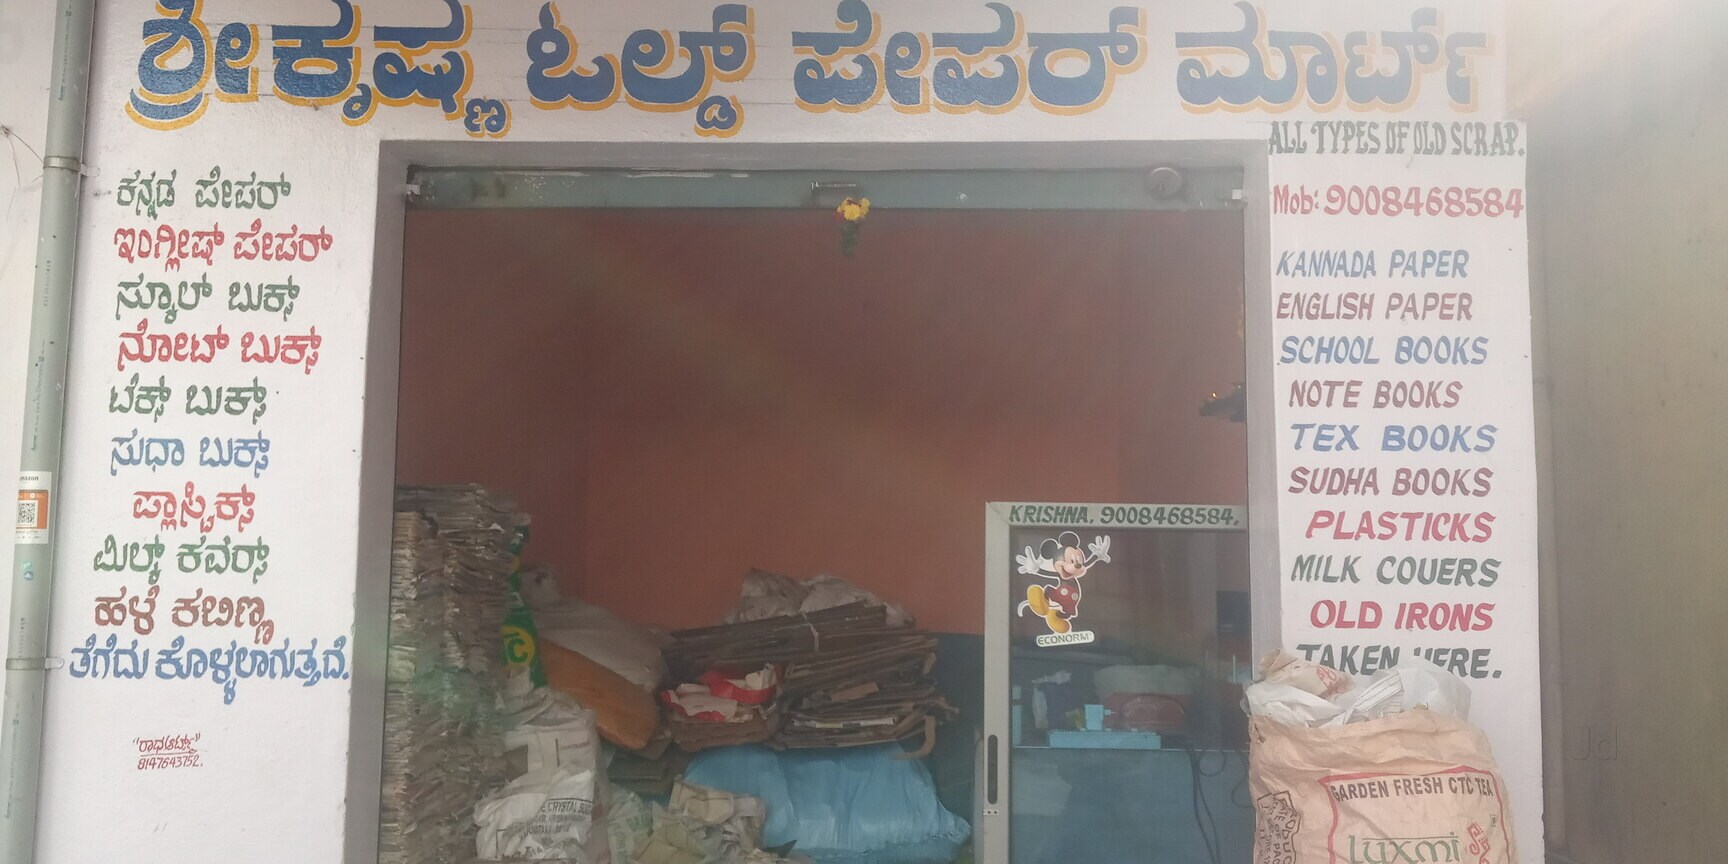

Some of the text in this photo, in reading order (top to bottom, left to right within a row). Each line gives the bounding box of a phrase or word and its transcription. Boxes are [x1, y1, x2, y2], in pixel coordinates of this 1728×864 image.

[791, 0, 1147, 116] ಪೇಪರ್
[1175, 0, 1495, 114] ಮಾರ್ಟ್
[1268, 120, 1526, 157] ALL TYPES OF OLD SCRAP.
[117, 166, 291, 220] ಕನ್ನಡ ಪೇಪರ್
[1273, 184, 1525, 218] Mob: 9008468584
[234, 218, 333, 262] ಪೇಪರ್
[1276, 250, 1469, 279] KANNADA PAPER
[116, 273, 300, 326] ಸ್ಕೂಲ್ ಬುಕ್ಸ್
[1277, 292, 1472, 321] ENGLISH PAPER
[117, 316, 322, 375] ನೋಟ್ ಬುಕ್ಸ್
[1280, 336, 1488, 365] SCHOOL BOOKS
[186, 377, 267, 425] ಬುಕ್ಸ್
[1289, 380, 1463, 408] NOTE BOOKS
[111, 429, 270, 478] ಸುಧಾ ಬುಕ್ಸ್
[1291, 424, 1497, 452] TEX BOOKS
[1288, 467, 1493, 497] SUDHA BOOKS
[1306, 510, 1495, 543] PLASTICKS
[93, 535, 165, 586] ಮಿಲ್ಕ್
[1291, 555, 1361, 583] MILK
[95, 585, 160, 635] ಹಳೆ
[1311, 600, 1495, 632] OLD IRONS
[69, 633, 149, 679] ತೆಗೆದು
[1330, 776, 1494, 802] GARDEN FRESH CTC TEA
